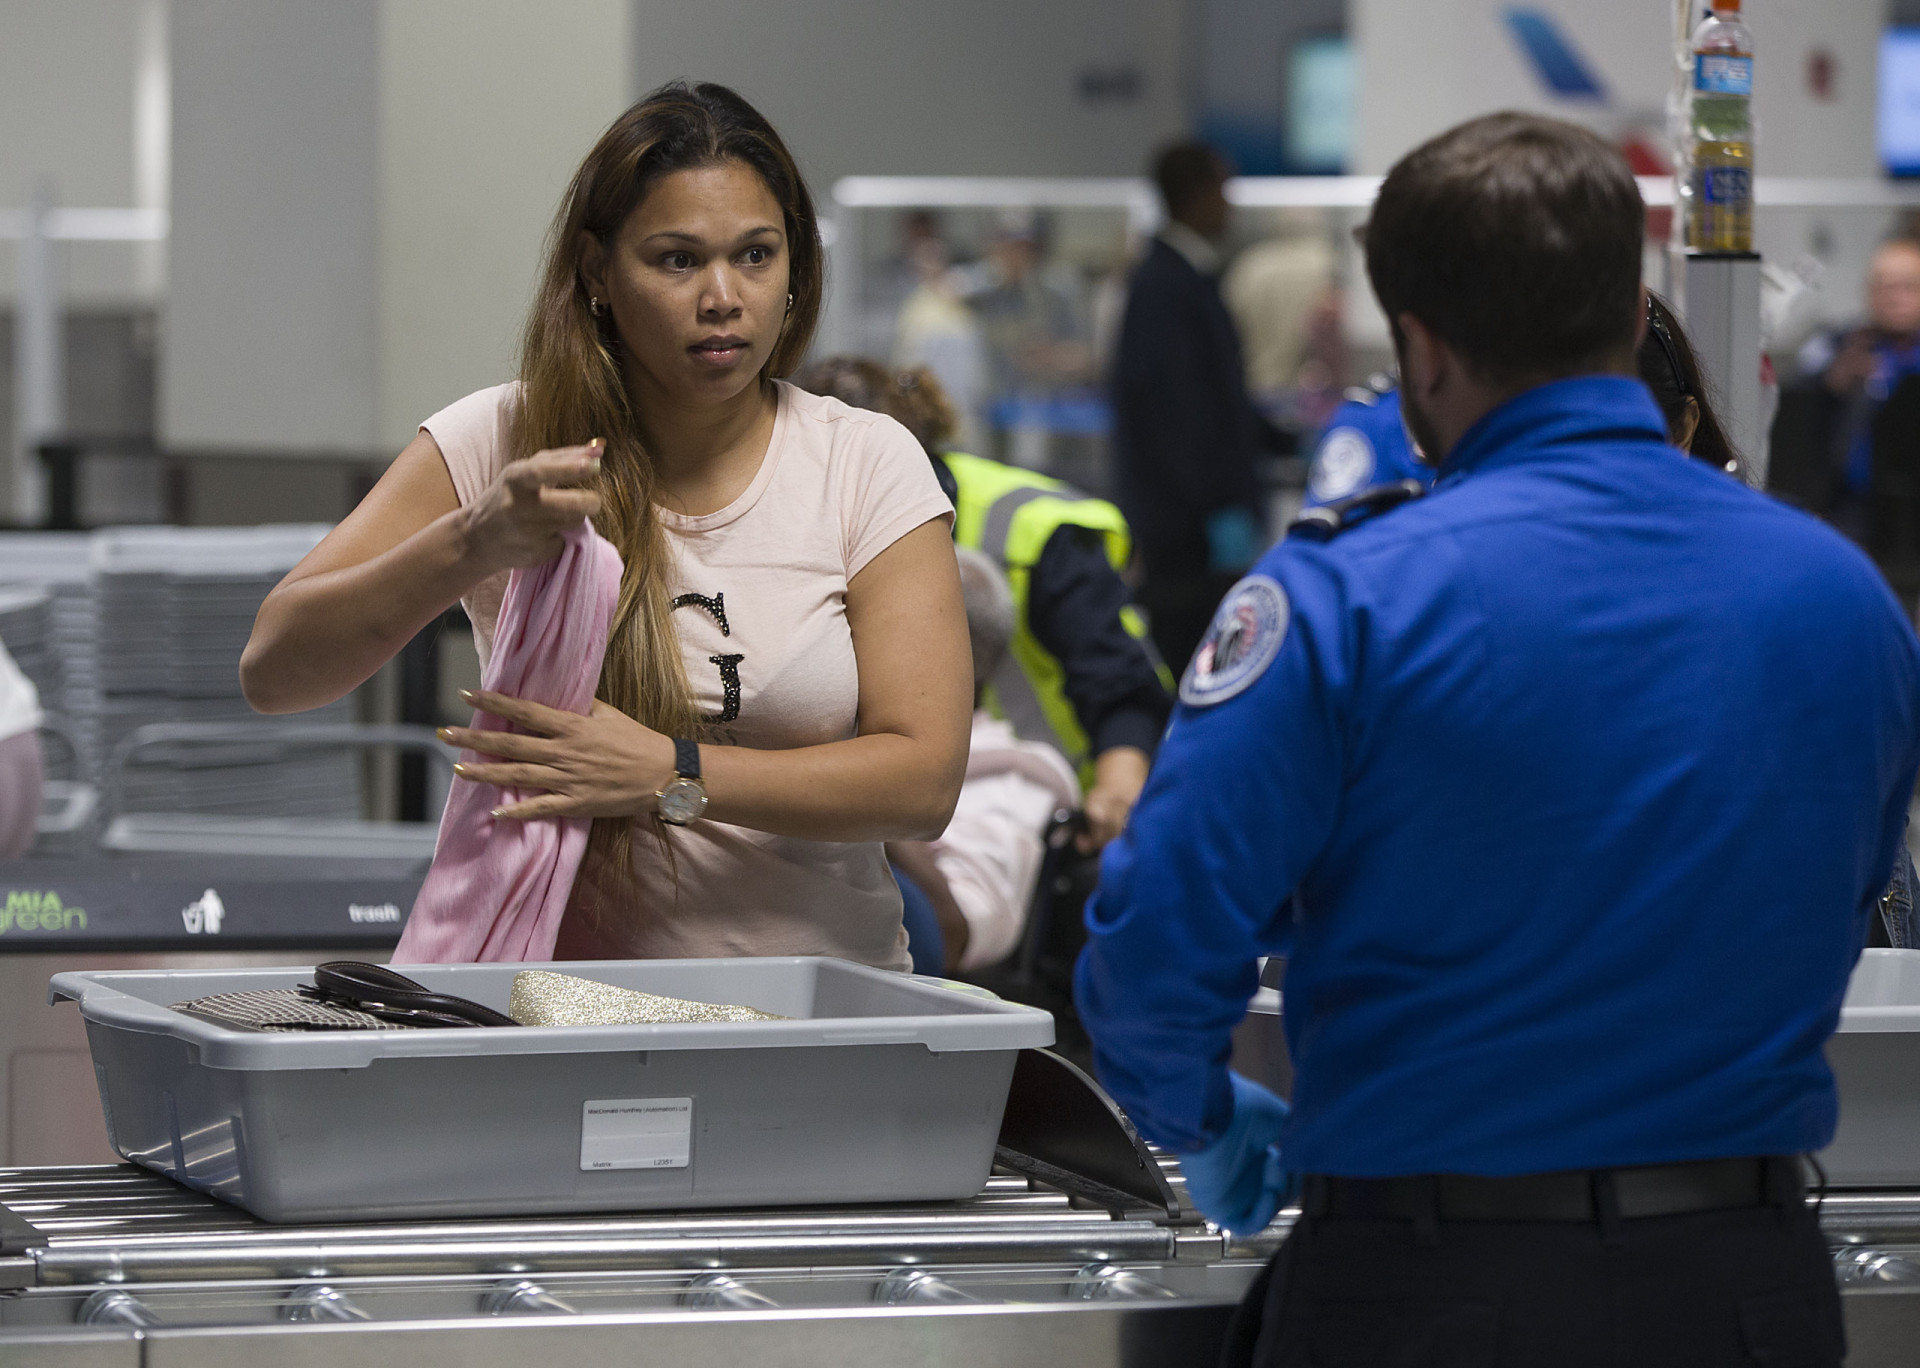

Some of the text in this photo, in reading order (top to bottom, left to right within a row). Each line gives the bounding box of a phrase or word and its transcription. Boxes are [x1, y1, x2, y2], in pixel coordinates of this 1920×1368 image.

[7, 890, 63, 912] MIA
[0, 906, 88, 935] reen
[349, 902, 400, 923] trash
